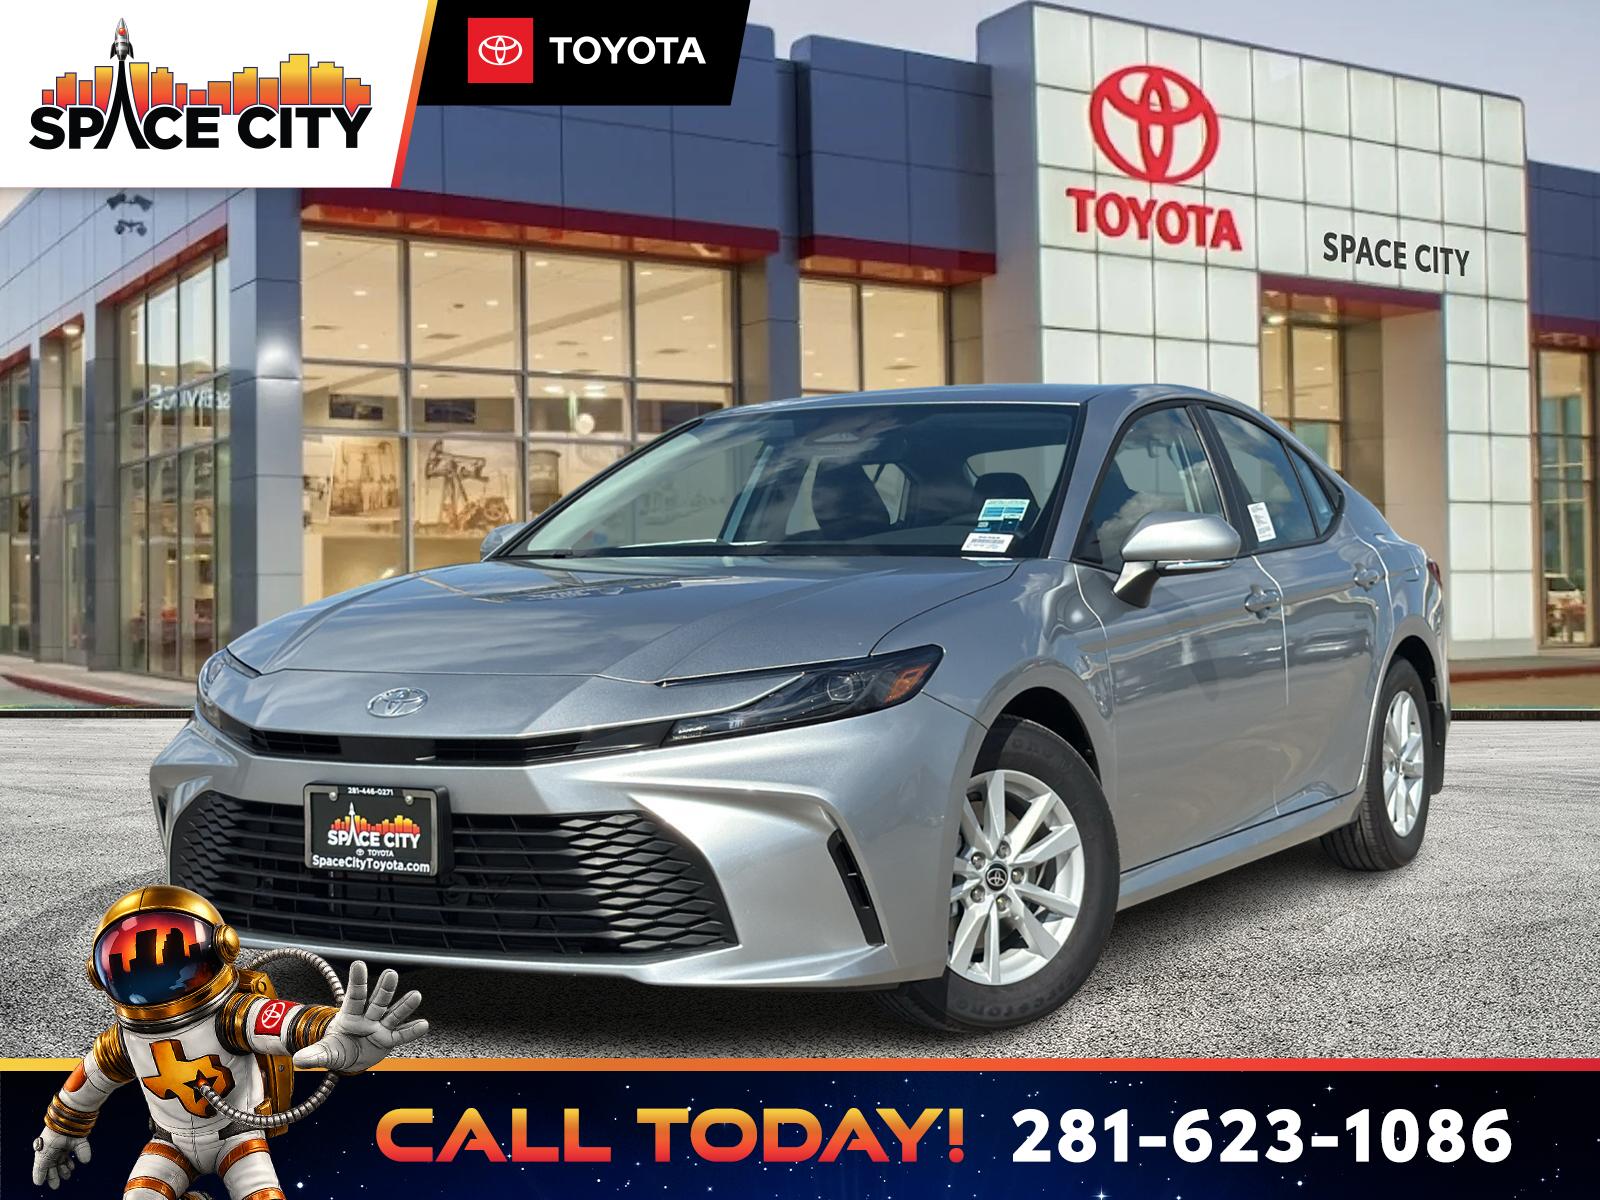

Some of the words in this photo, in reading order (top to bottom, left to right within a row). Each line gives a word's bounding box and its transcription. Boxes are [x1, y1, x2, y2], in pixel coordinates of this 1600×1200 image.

[1066, 186, 1243, 252] TOYOTA
[1322, 230, 1408, 271] SPACE
[1413, 242, 1471, 277] CITY
[327, 827, 381, 848] SPACE
[383, 831, 421, 849] CITY
[312, 854, 431, 873] SpaceCityToyota.com
[367, 848, 395, 858] TOYOTA
